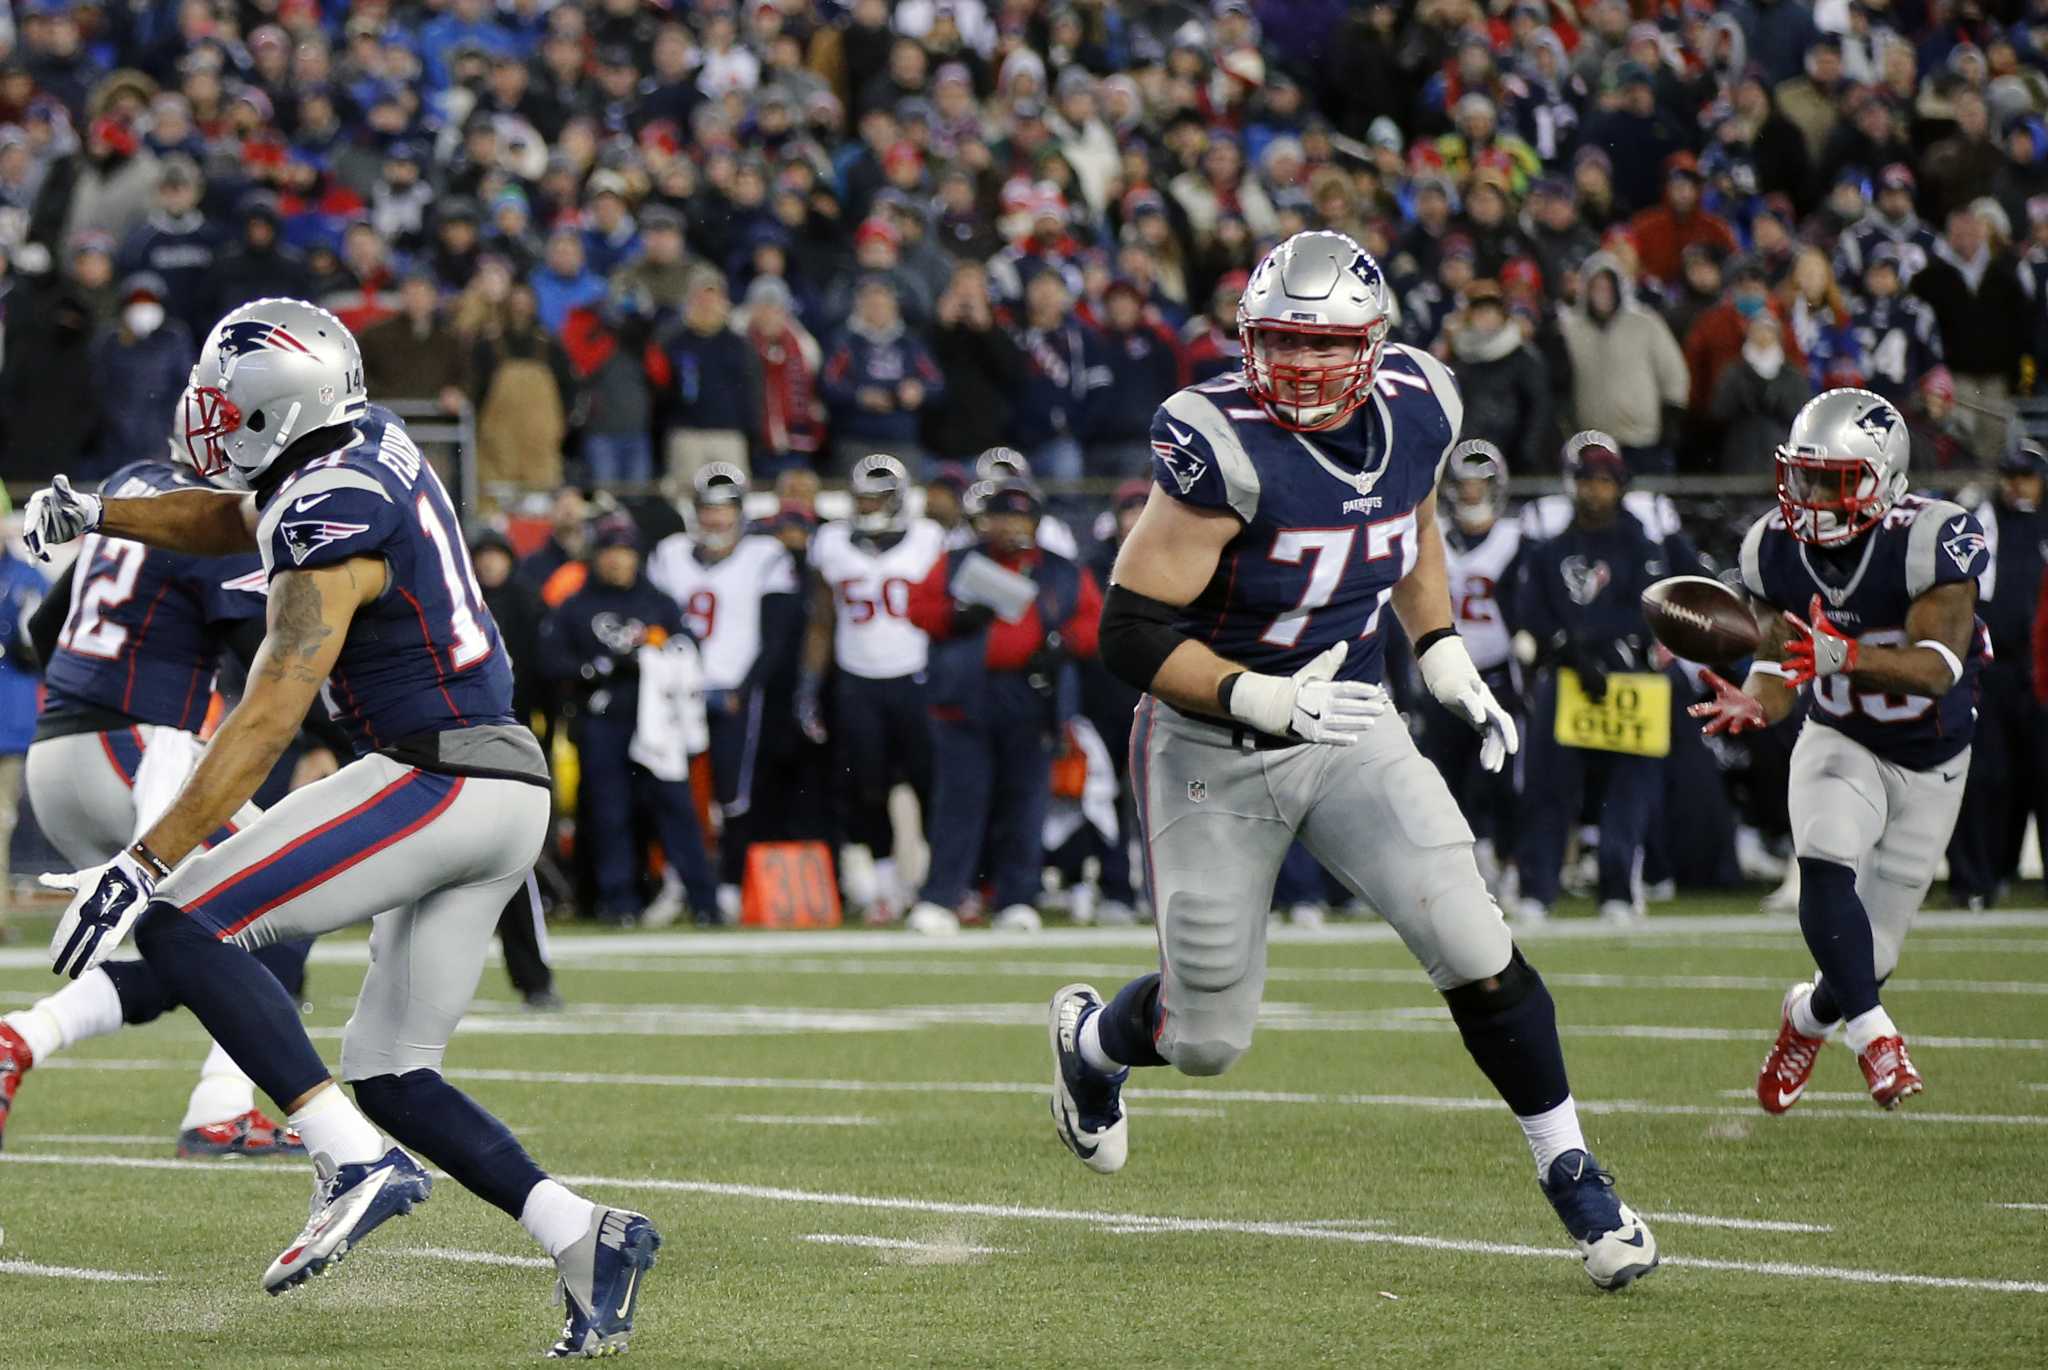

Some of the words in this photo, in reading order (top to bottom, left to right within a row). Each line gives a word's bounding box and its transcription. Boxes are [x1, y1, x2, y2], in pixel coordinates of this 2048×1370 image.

[345, 367, 361, 394] 14
[58, 532, 146, 659] 12
[839, 577, 911, 623] 50
[1258, 508, 1418, 648] 77
[761, 847, 834, 921] 30
